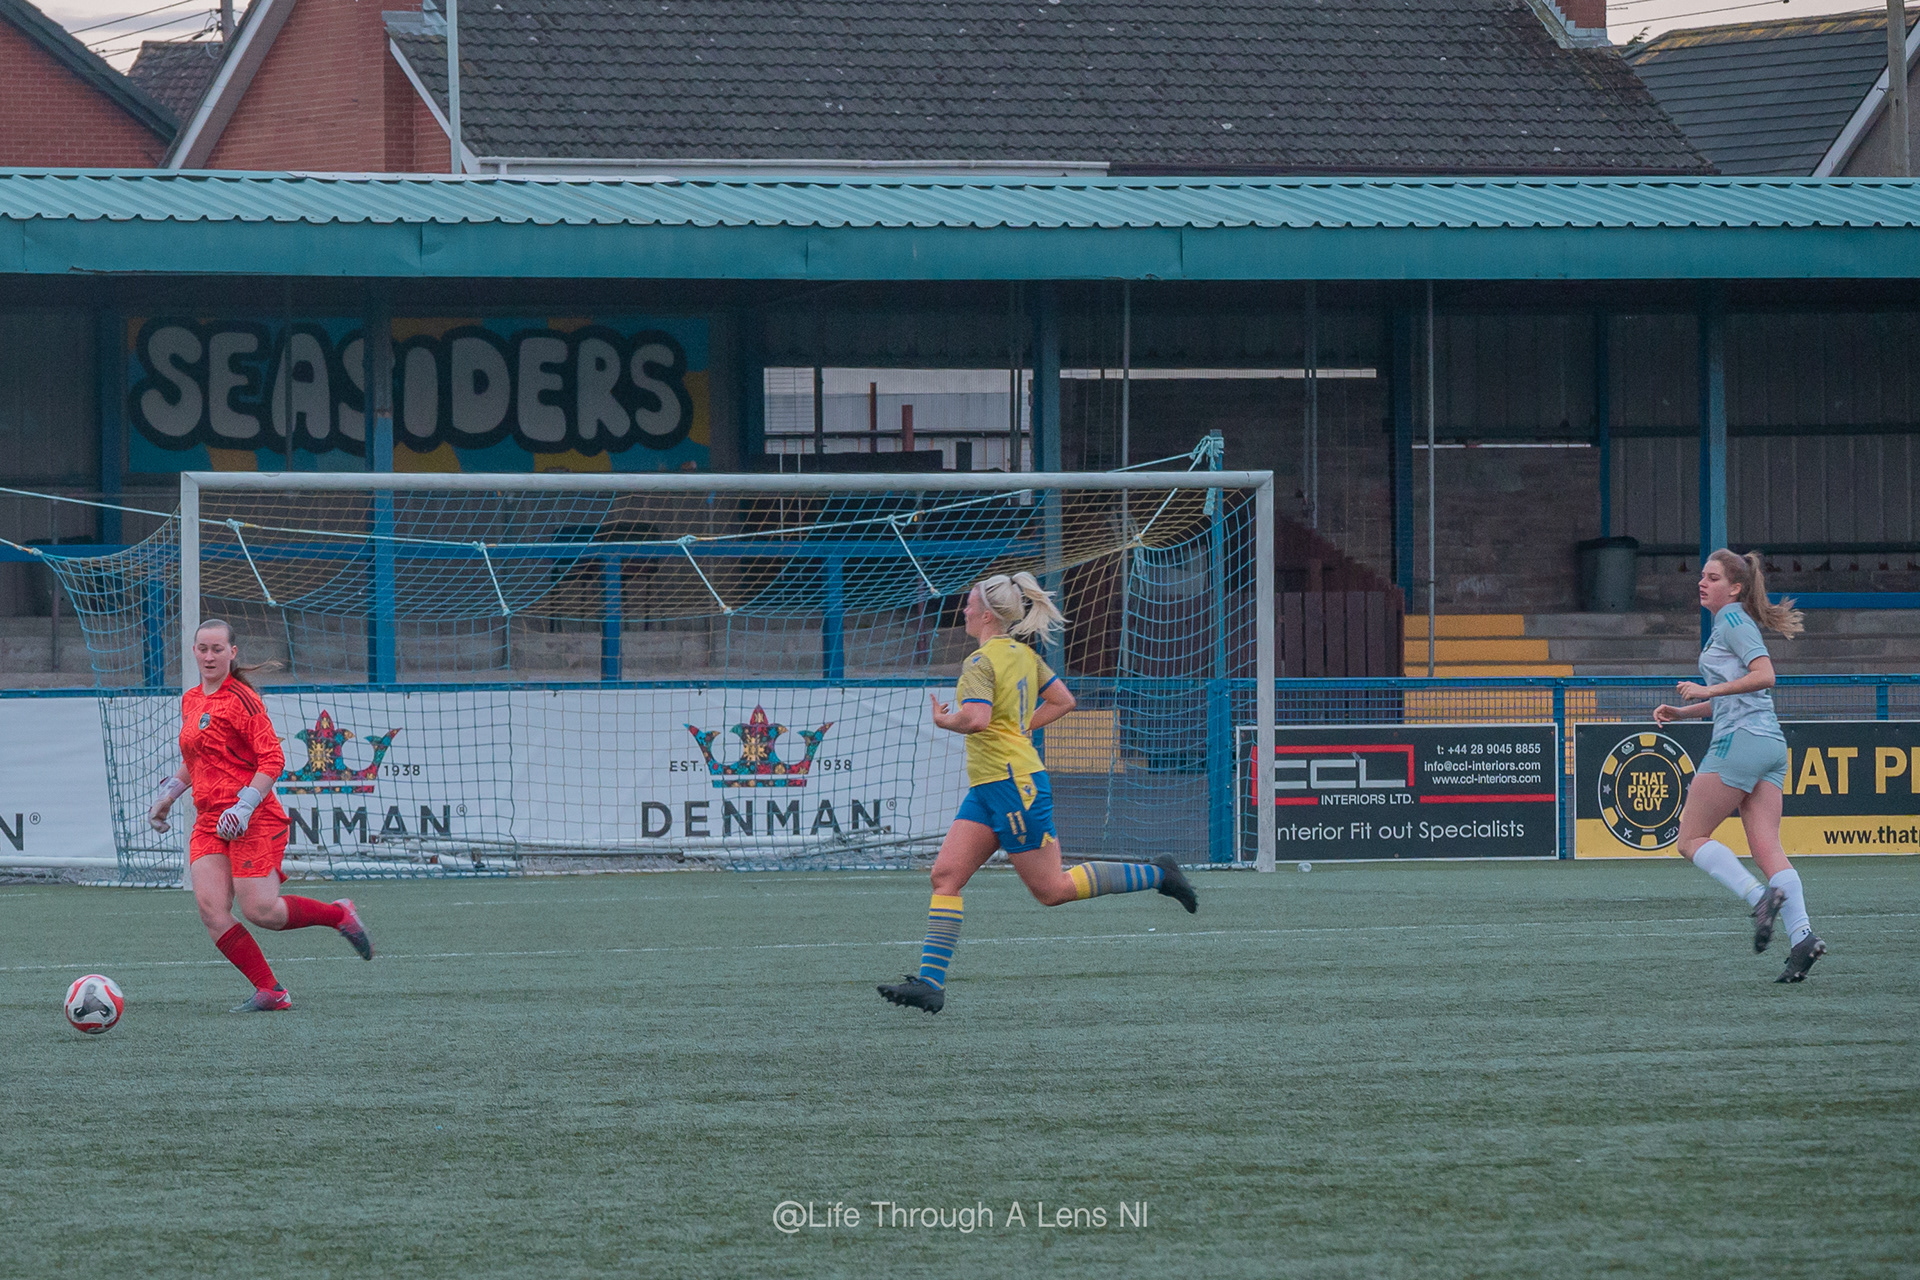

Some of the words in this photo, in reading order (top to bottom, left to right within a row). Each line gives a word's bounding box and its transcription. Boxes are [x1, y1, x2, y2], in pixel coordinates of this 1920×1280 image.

[138, 323, 685, 446] SEASIDERS
[1448, 745, 1467, 755] +44
[1471, 744, 1484, 755] 28
[1487, 744, 1513, 755] 9045
[1516, 744, 1541, 754] 8855
[385, 765, 420, 777] 1938
[670, 761, 703, 772] EST.
[817, 759, 852, 771] 1938
[1424, 761, 1541, 772] info@ccl-interiors.com
[1782, 747, 1859, 795] AT
[1432, 774, 1541, 785] www.ccl-interiors.com
[1630, 772, 1666, 786] THAT
[1628, 785, 1669, 798] PRIZE
[1321, 794, 1386, 805] INTERIORS
[1389, 794, 1414, 804] LTD.
[1633, 798, 1662, 811] GUY
[1006, 810, 1027, 835] 11
[1277, 822, 1344, 840] nterior
[1350, 822, 1372, 839] Fit
[1378, 822, 1413, 839] out
[1418, 820, 1525, 842] Specialists
[1823, 825, 1920, 847] www.that
